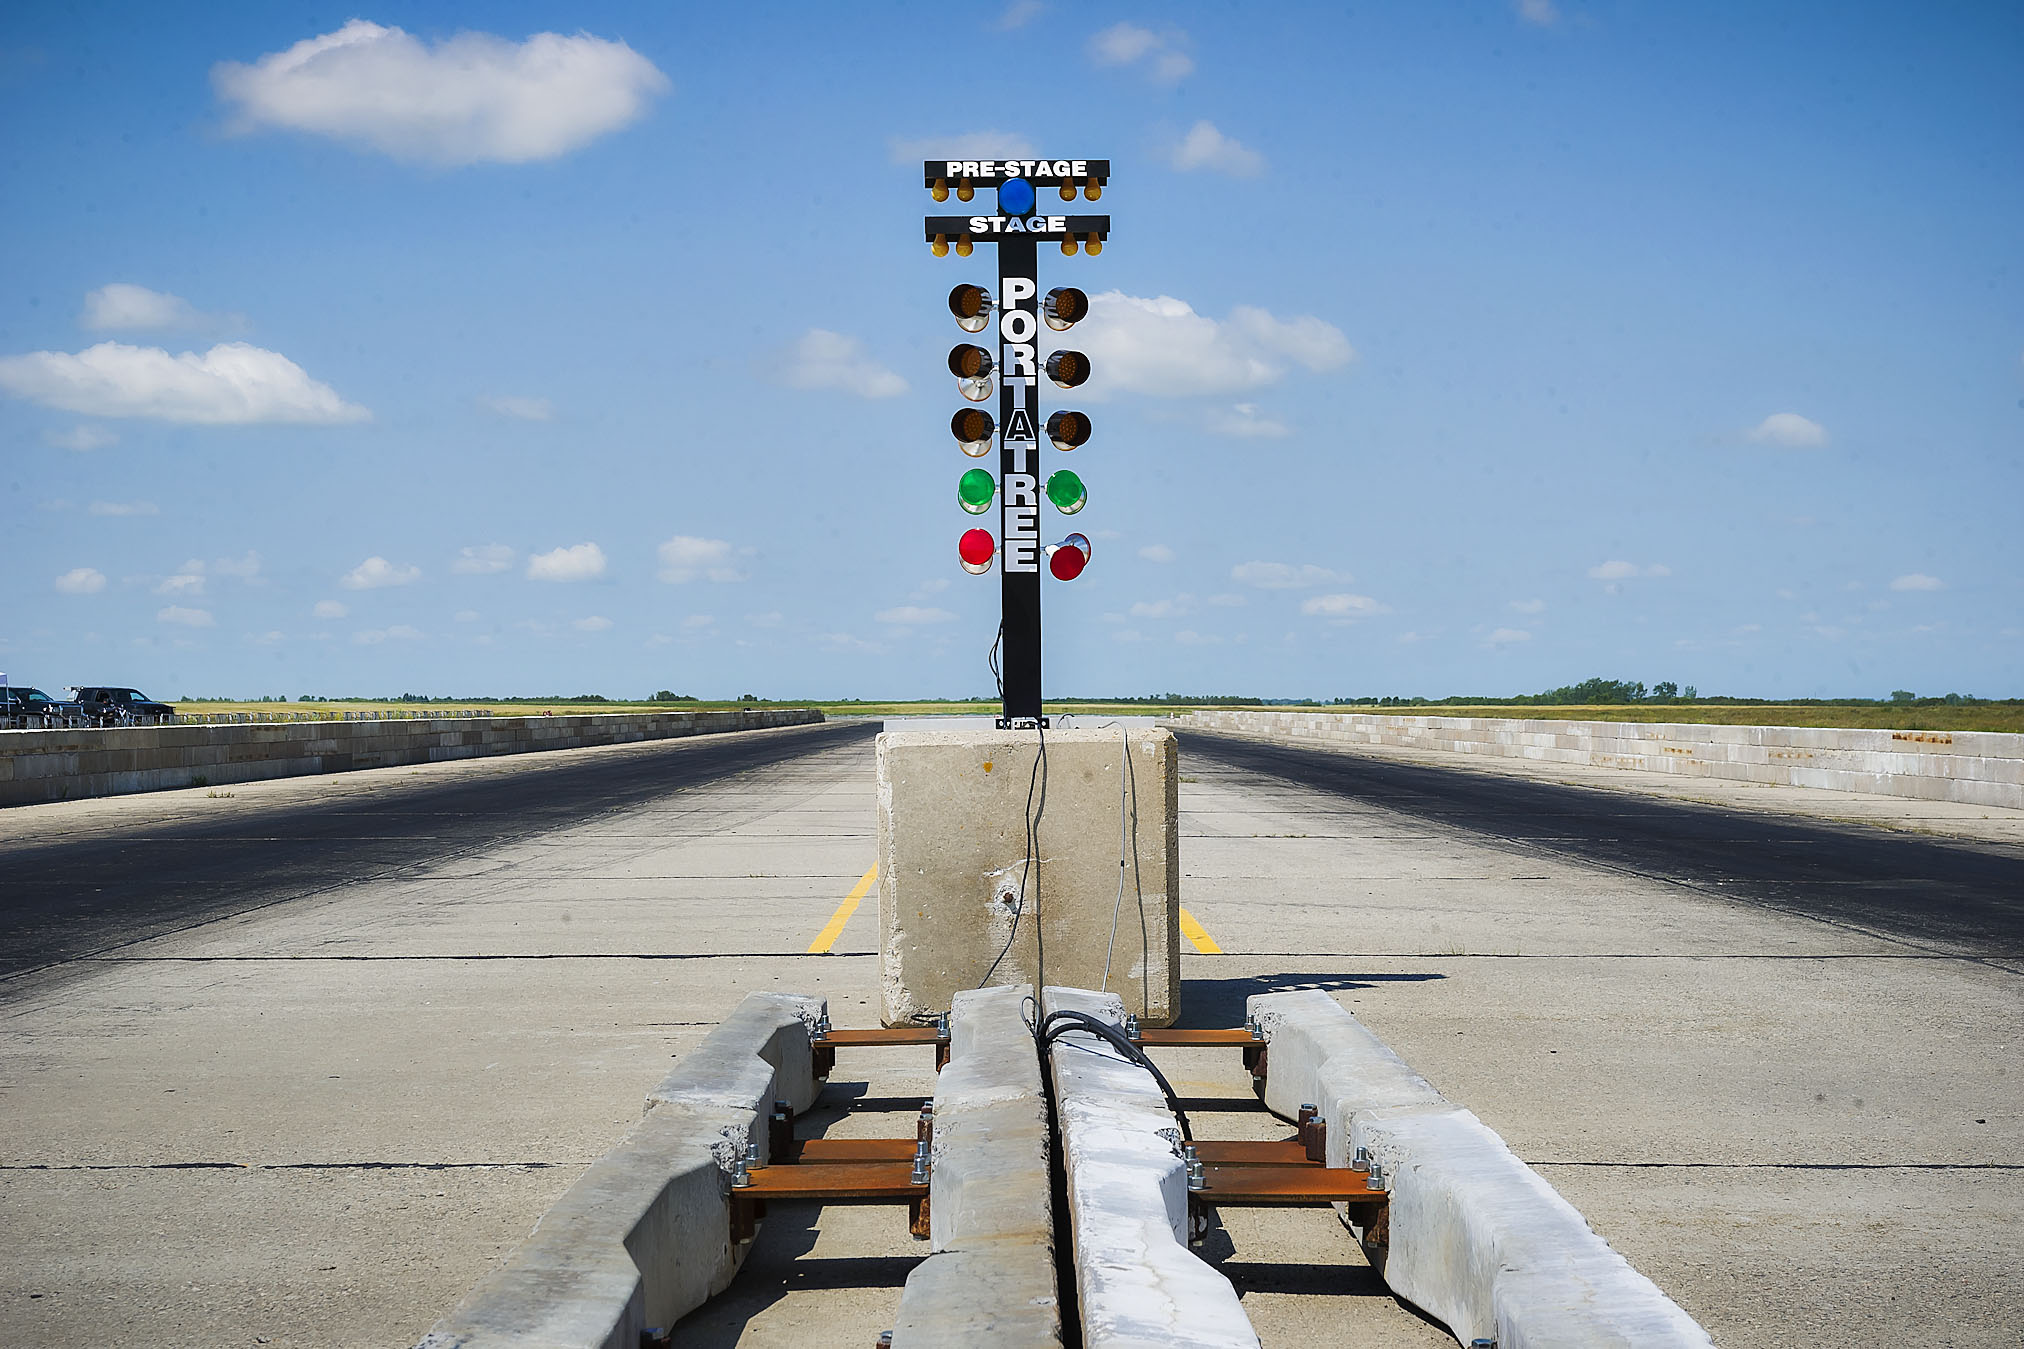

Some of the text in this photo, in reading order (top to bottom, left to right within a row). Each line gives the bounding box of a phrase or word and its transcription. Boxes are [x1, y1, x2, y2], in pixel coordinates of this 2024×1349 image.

[946, 160, 1088, 178] PRE-STAGE
[968, 216, 1067, 233] STAGE
[1000, 277, 1038, 573] PORTATREE
